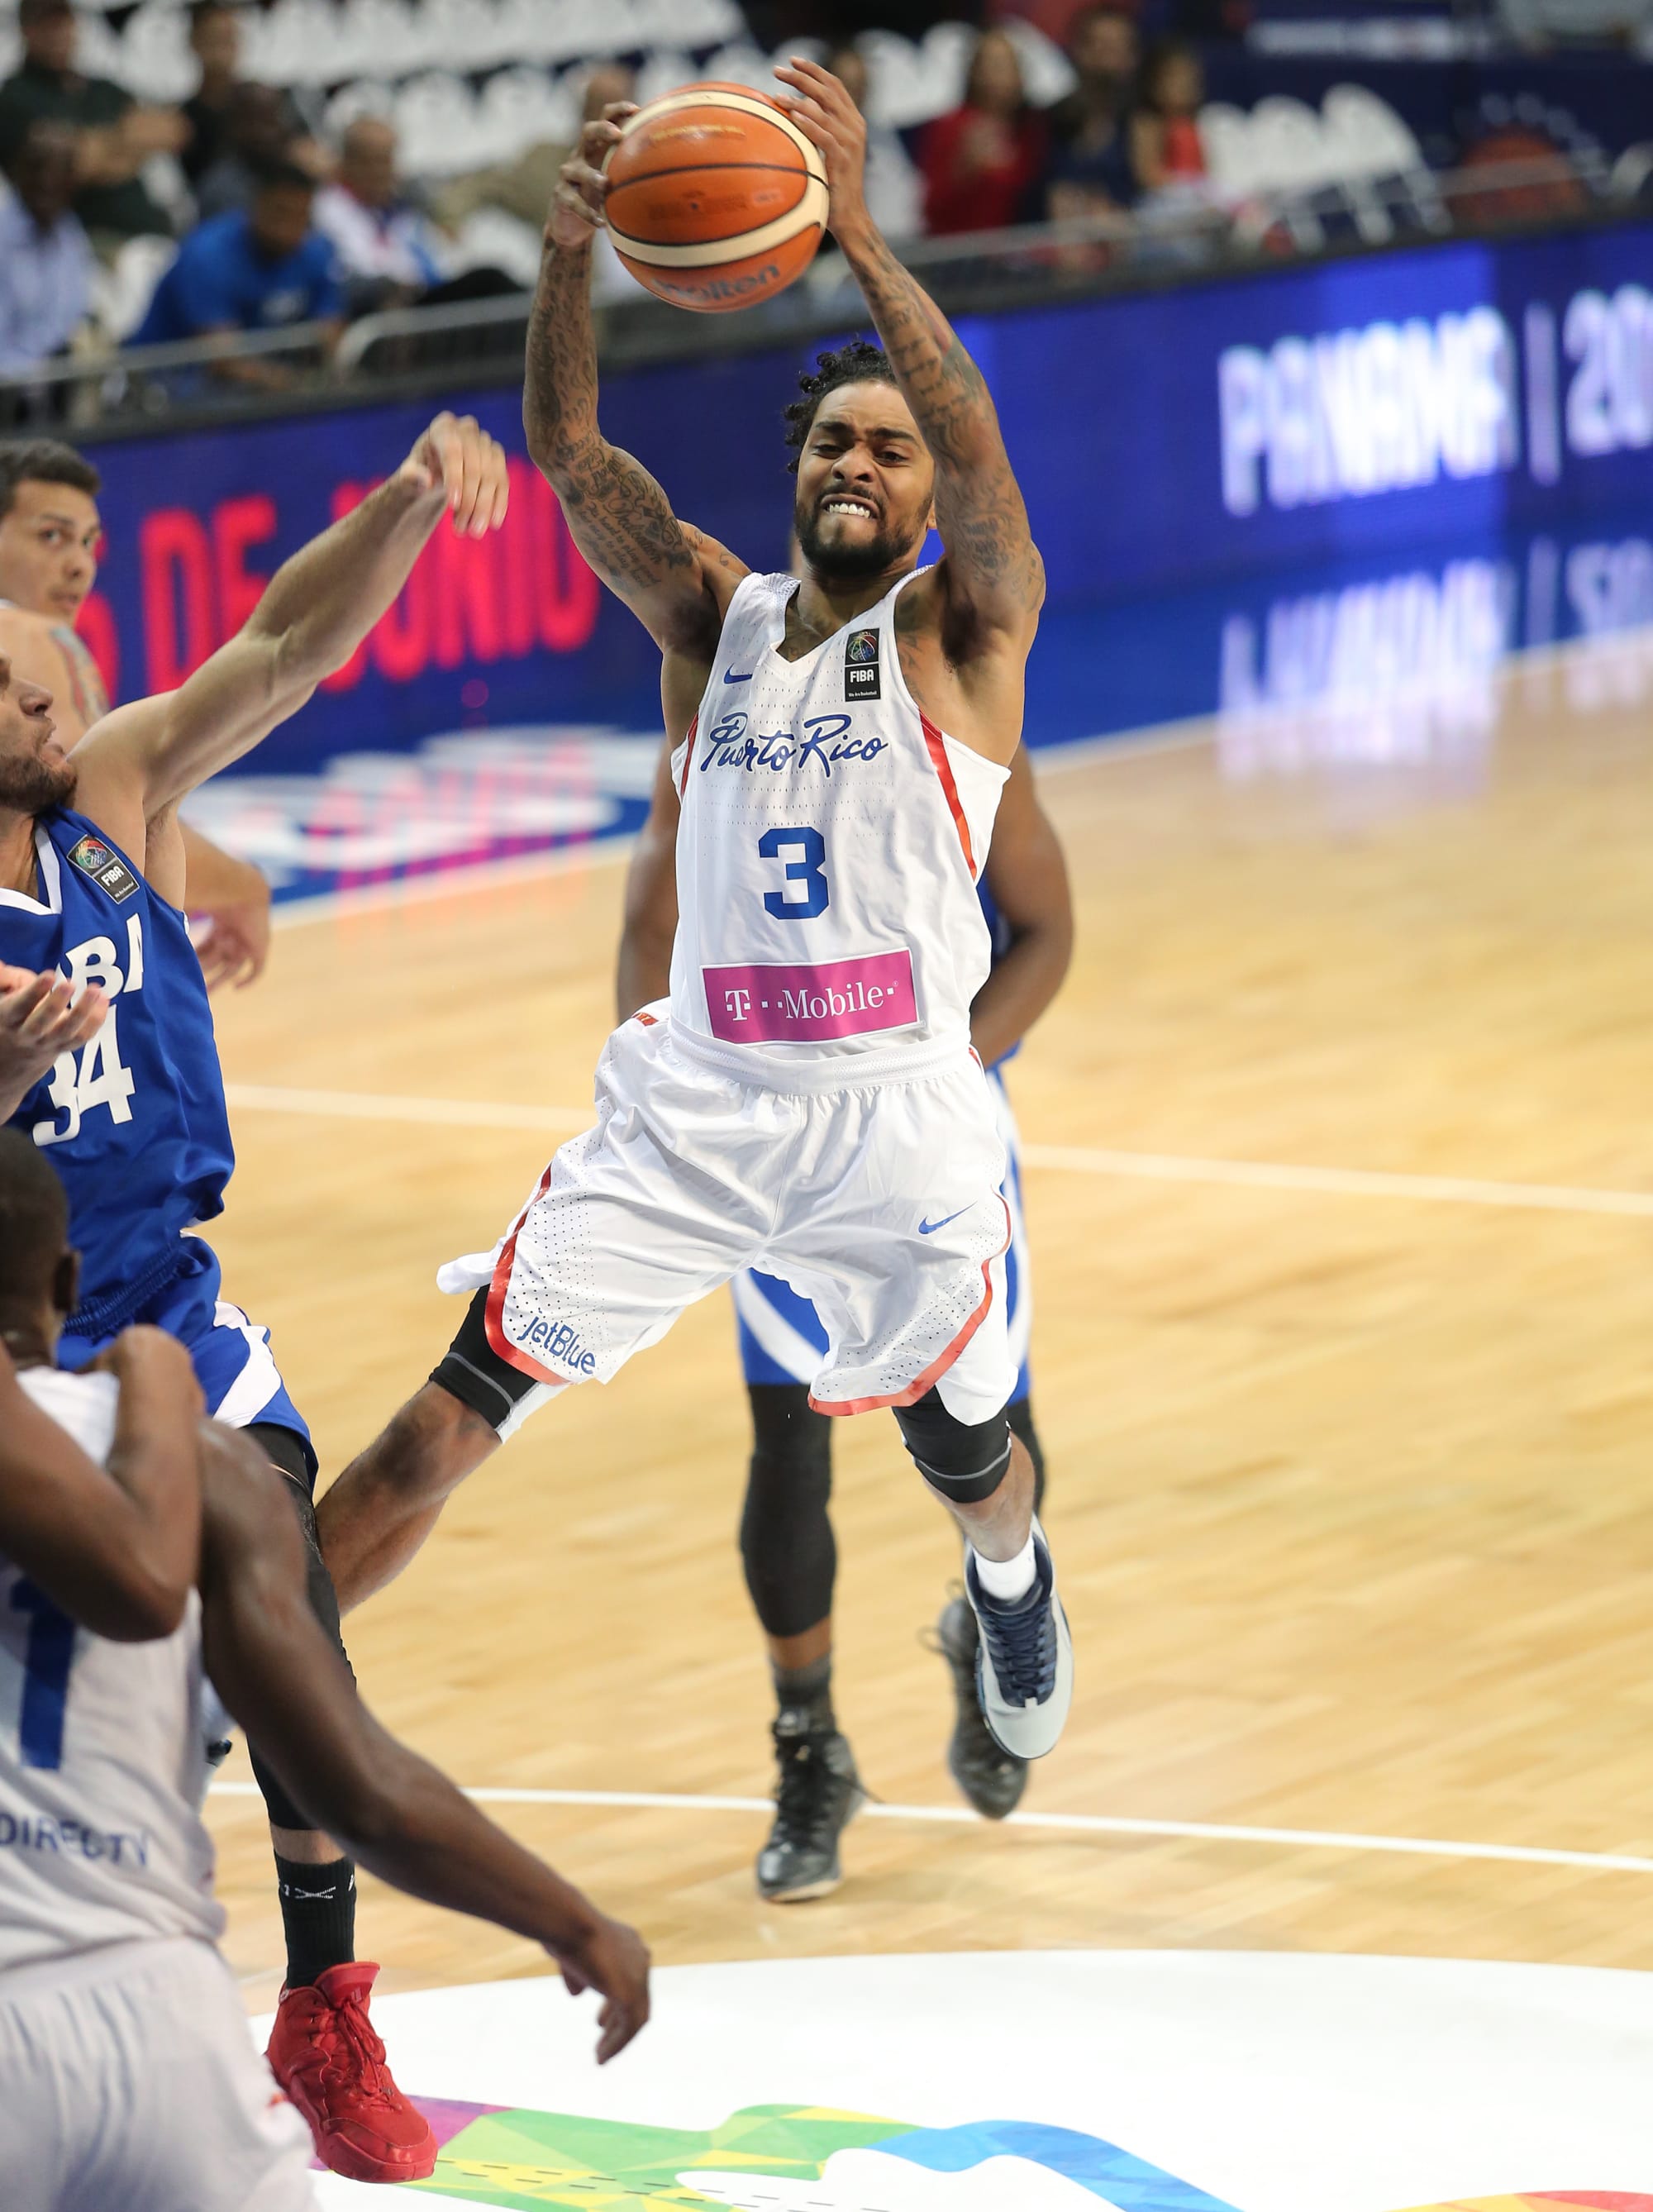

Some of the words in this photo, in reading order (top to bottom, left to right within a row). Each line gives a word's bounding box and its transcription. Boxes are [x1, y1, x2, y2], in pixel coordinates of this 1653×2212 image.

[850, 669, 874, 684] FIBA
[700, 712, 797, 772] Puerto
[798, 713, 888, 778] Rico
[101, 865, 124, 887] FIBA
[758, 827, 830, 920] 3
[517, 1307, 596, 1375] jetBlue
